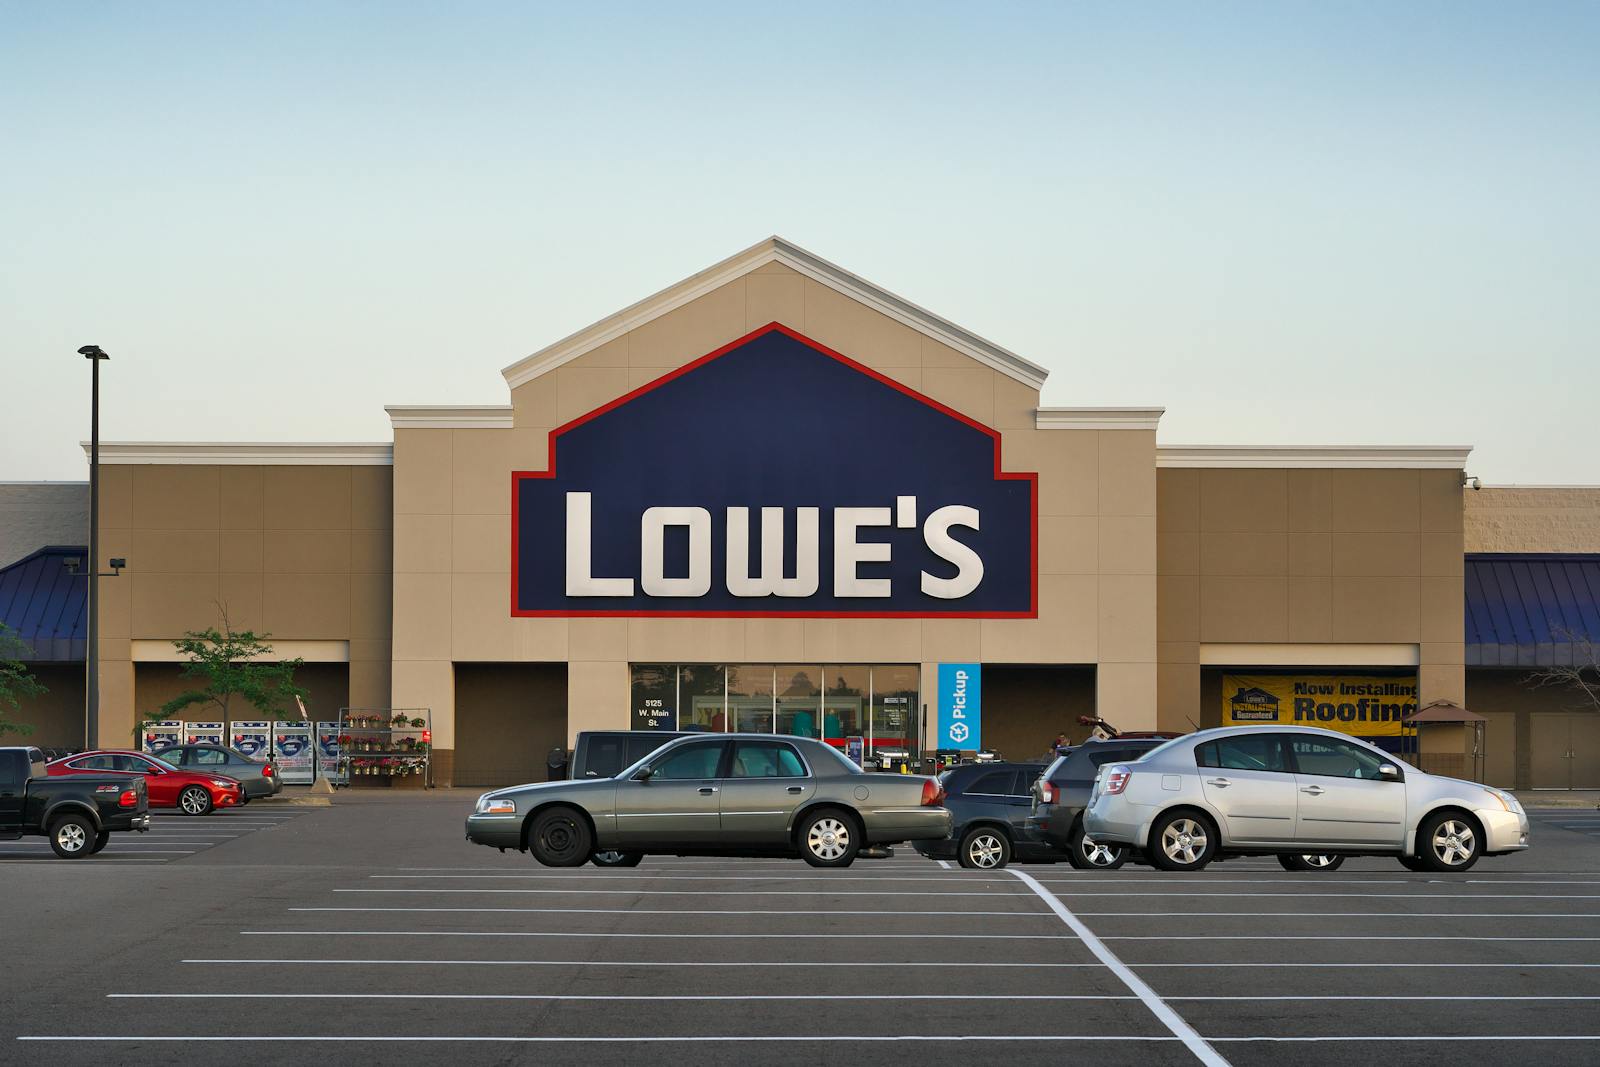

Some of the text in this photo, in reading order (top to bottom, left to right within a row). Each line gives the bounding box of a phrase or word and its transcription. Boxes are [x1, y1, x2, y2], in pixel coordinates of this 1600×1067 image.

[565, 491, 985, 599] LOWE'S
[1294, 682, 1334, 695] Now
[952, 669, 969, 720] Pickup
[645, 699, 663, 707] 5125
[638, 709, 669, 717] W. Main
[648, 719, 659, 727] St.
